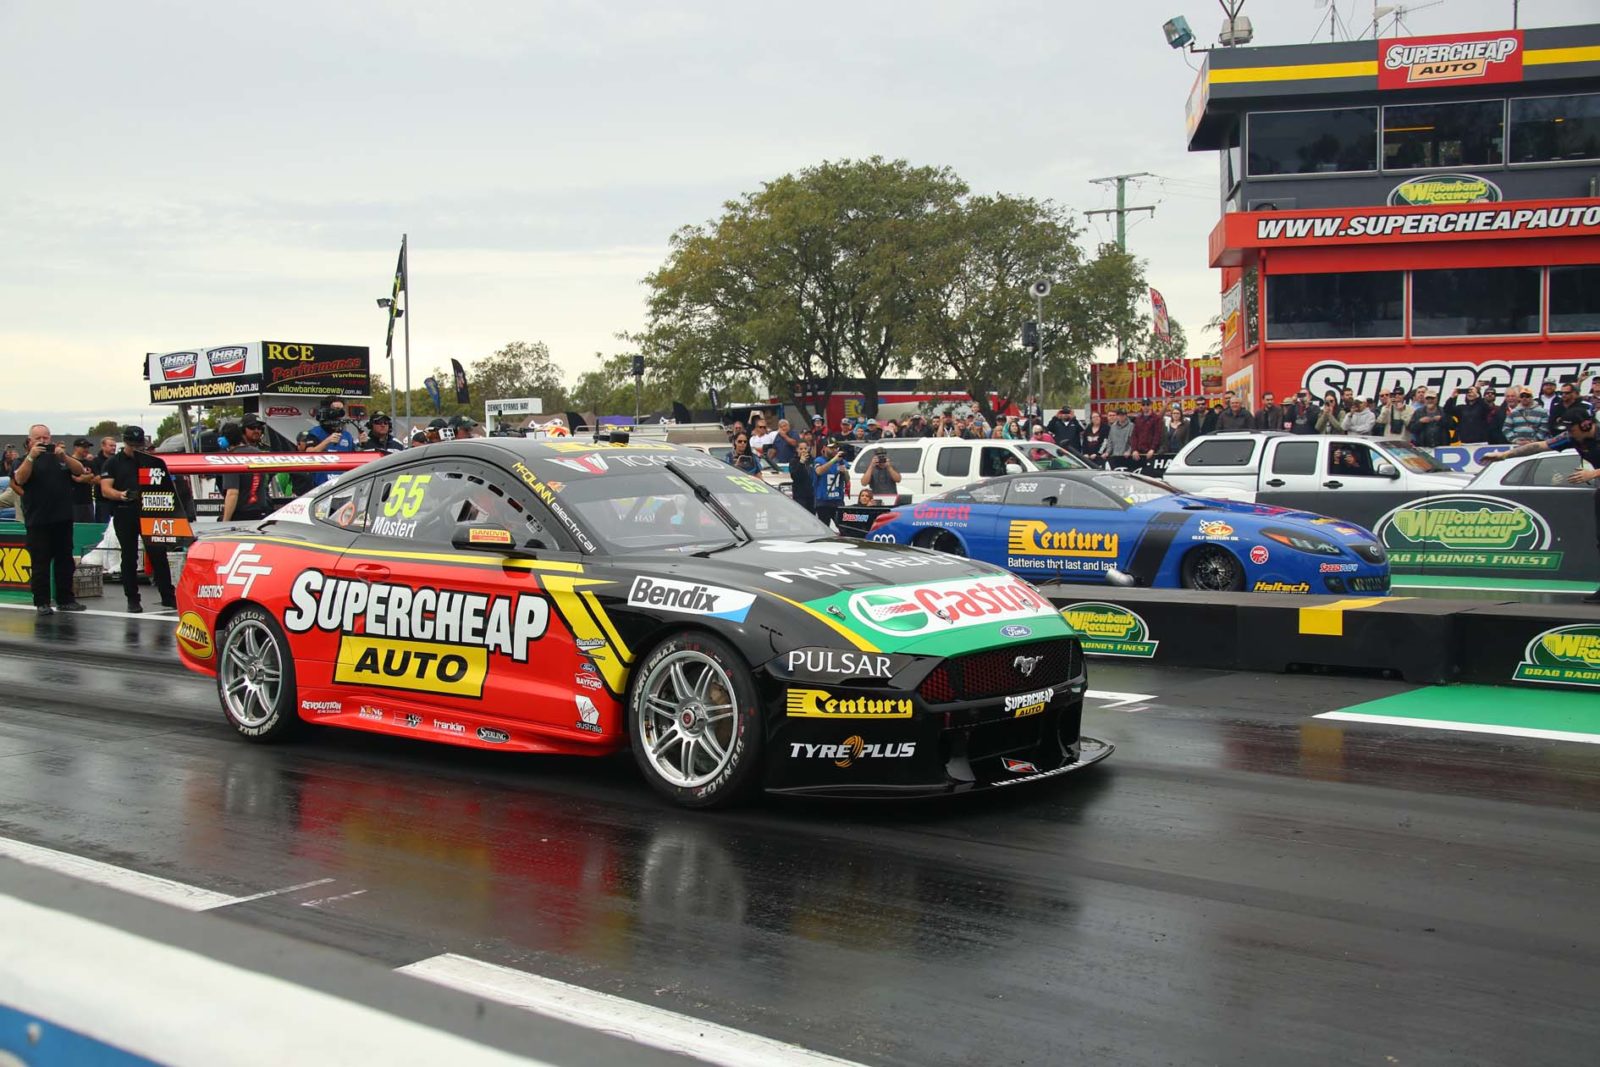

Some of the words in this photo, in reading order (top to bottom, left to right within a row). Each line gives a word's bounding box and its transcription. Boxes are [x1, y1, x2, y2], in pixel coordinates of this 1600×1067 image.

[1387, 40, 1516, 68] SUPERCHEAP
[1419, 62, 1477, 75] AUTO
[165, 354, 194, 364] IHRA
[212, 348, 243, 359] IHRA
[267, 343, 315, 361] RCE
[272, 357, 361, 381] Performance
[153, 382, 259, 401] willowbankraceway.com.au
[278, 384, 363, 396] willowbankraceway.com.au
[205, 454, 340, 465] SUPERCHEAP
[726, 475, 769, 494] 55
[144, 496, 167, 507] TRADIE
[384, 474, 432, 518] 55
[913, 503, 971, 521] Garrett
[152, 519, 175, 535] ACT
[371, 515, 417, 539] Mostert
[551, 502, 597, 553] electrical
[912, 520, 943, 528] ADVANCING
[945, 521, 968, 529] MOTION
[1394, 508, 1528, 538] Willowbank
[1008, 520, 1119, 558] Century
[1433, 523, 1513, 544] Raceway
[1008, 557, 1045, 569] Batteries
[1047, 558, 1065, 570] that
[1065, 560, 1081, 570] last
[1083, 560, 1099, 571] and
[1101, 561, 1118, 571] last
[1415, 552, 1487, 564] RACING'S
[1491, 554, 1552, 566] FINEST
[764, 561, 872, 584] NAVY
[197, 585, 225, 599] LOGISTICS
[631, 578, 720, 612] Bendix
[1254, 581, 1310, 592] Haltech
[913, 577, 1055, 621] Castrol
[228, 610, 265, 630] DUNLOP
[285, 569, 551, 662] SUPERCHEAP
[1117, 643, 1150, 652] FINEST
[353, 647, 469, 683] AUTO
[787, 650, 892, 678] PULSAR
[1523, 668, 1561, 677] DRAG
[302, 700, 342, 711] REVOLUTION
[786, 688, 913, 719] Century
[1004, 687, 1054, 713] SUPERCHEAP
[1019, 705, 1042, 717] AUTO
[433, 718, 466, 733] franklin
[576, 721, 603, 734] australia
[698, 736, 745, 798] DUNLOP
